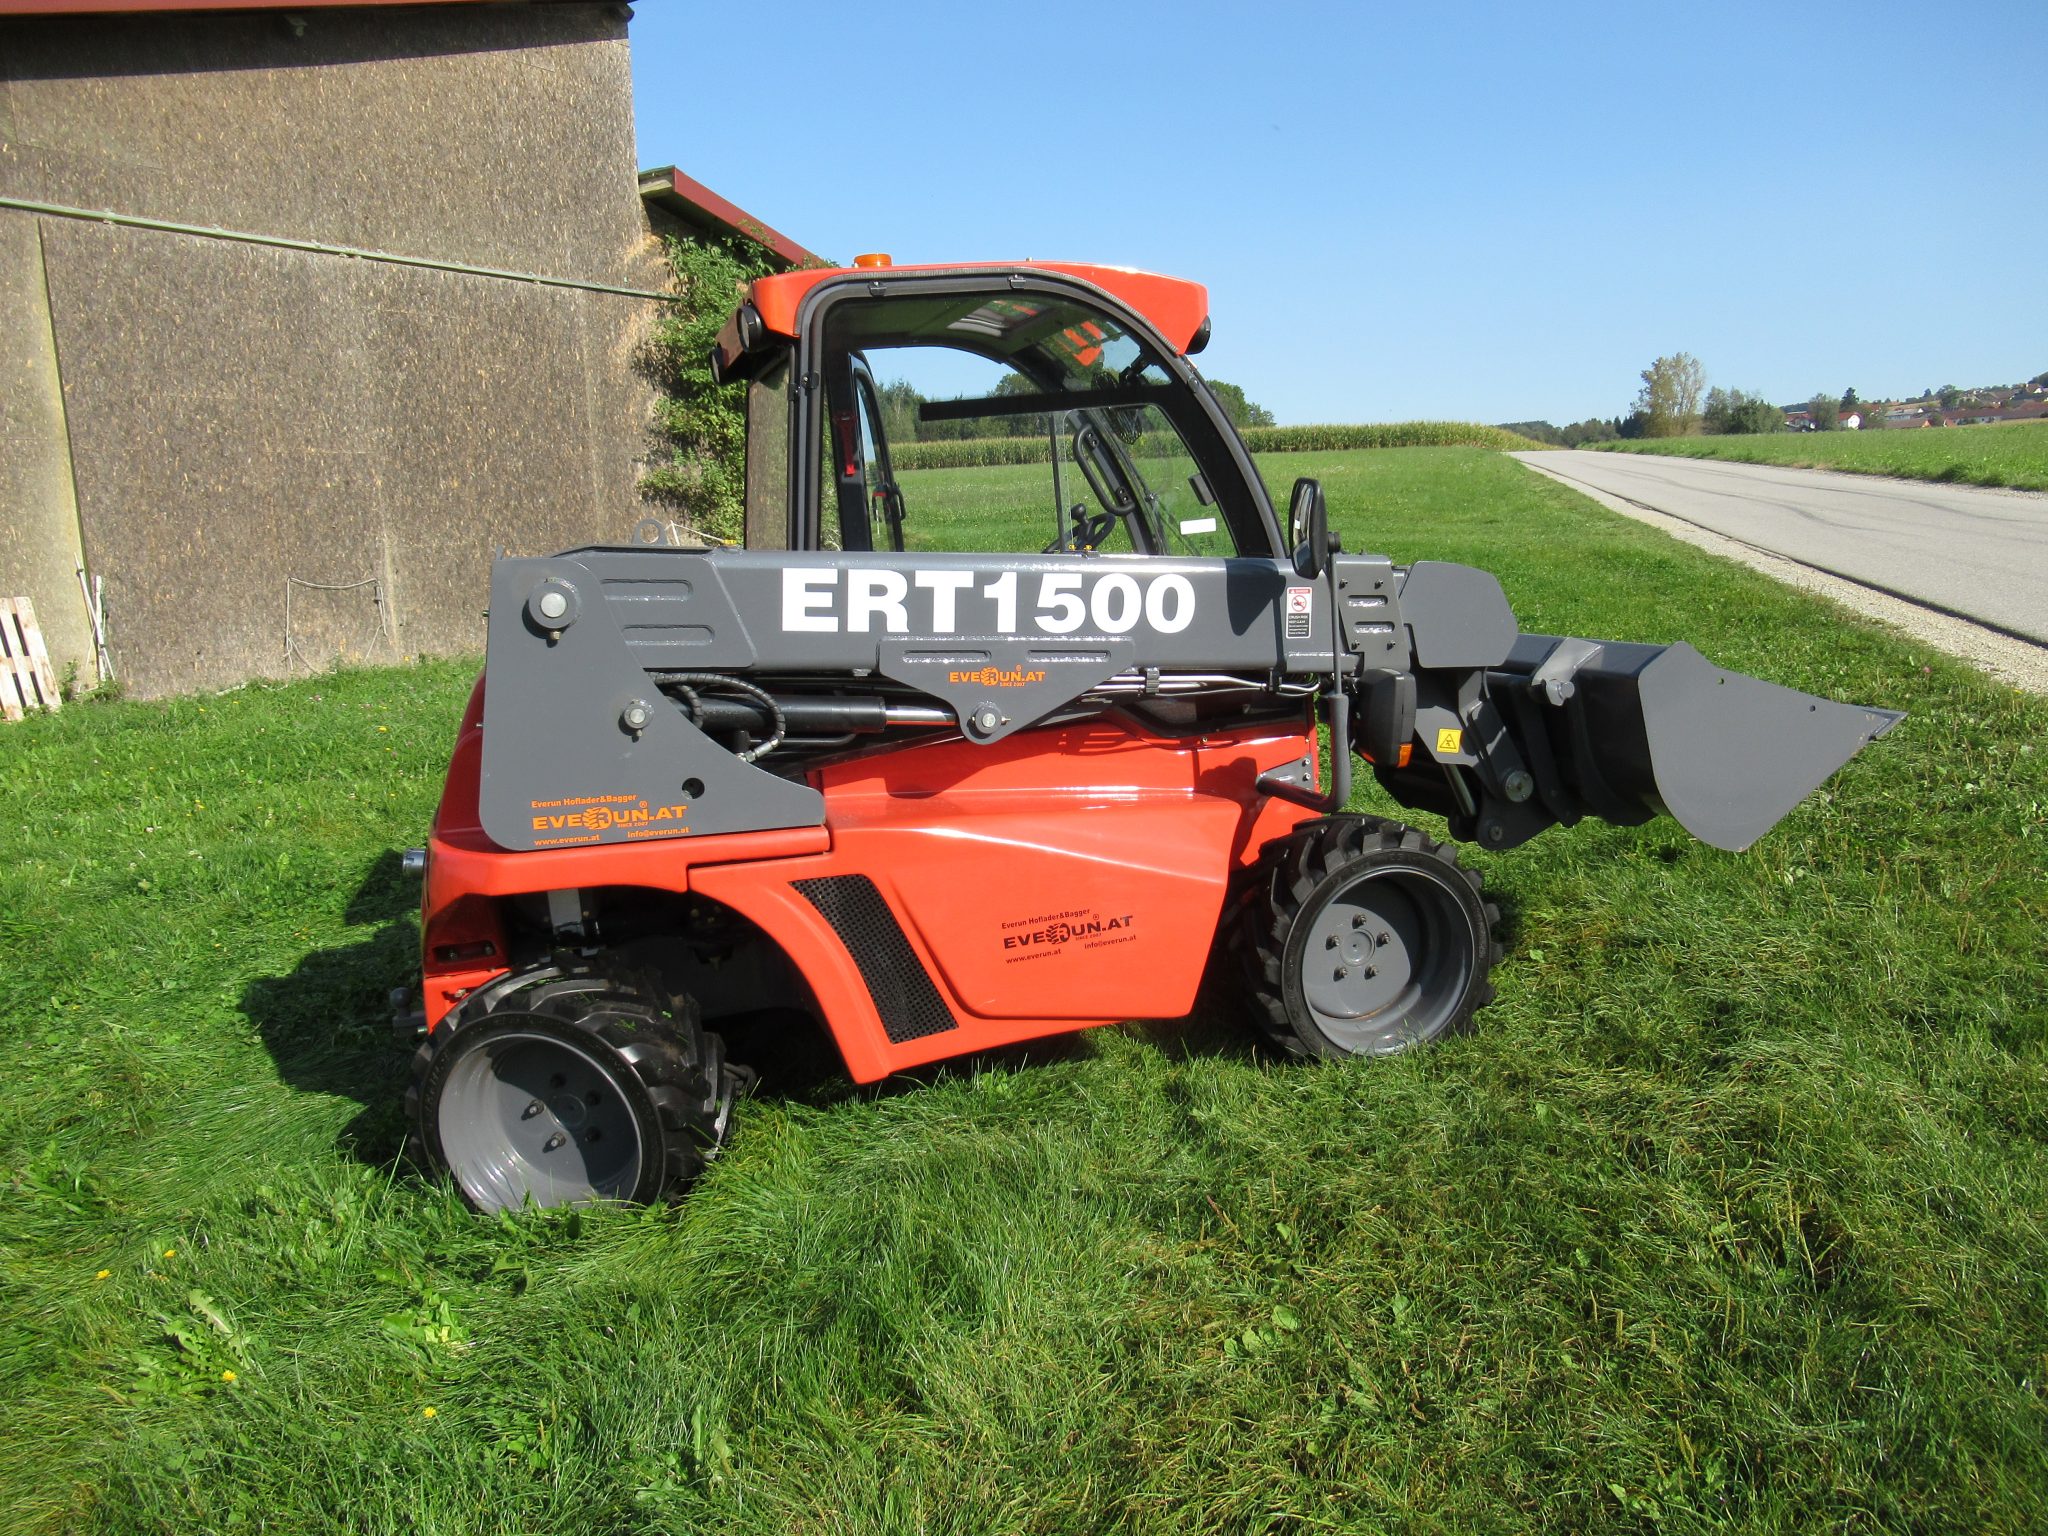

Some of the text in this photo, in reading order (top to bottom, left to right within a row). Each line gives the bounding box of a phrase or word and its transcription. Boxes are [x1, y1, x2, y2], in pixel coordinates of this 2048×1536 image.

[781, 567, 1196, 634] ERT1500
[531, 794, 637, 809] Everun Hoflader&Bagger
[534, 834, 600, 847] www.everun.at
[1001, 908, 1091, 930] Everun Hoflader&Bagger
[1006, 948, 1062, 965] www.everun.at
